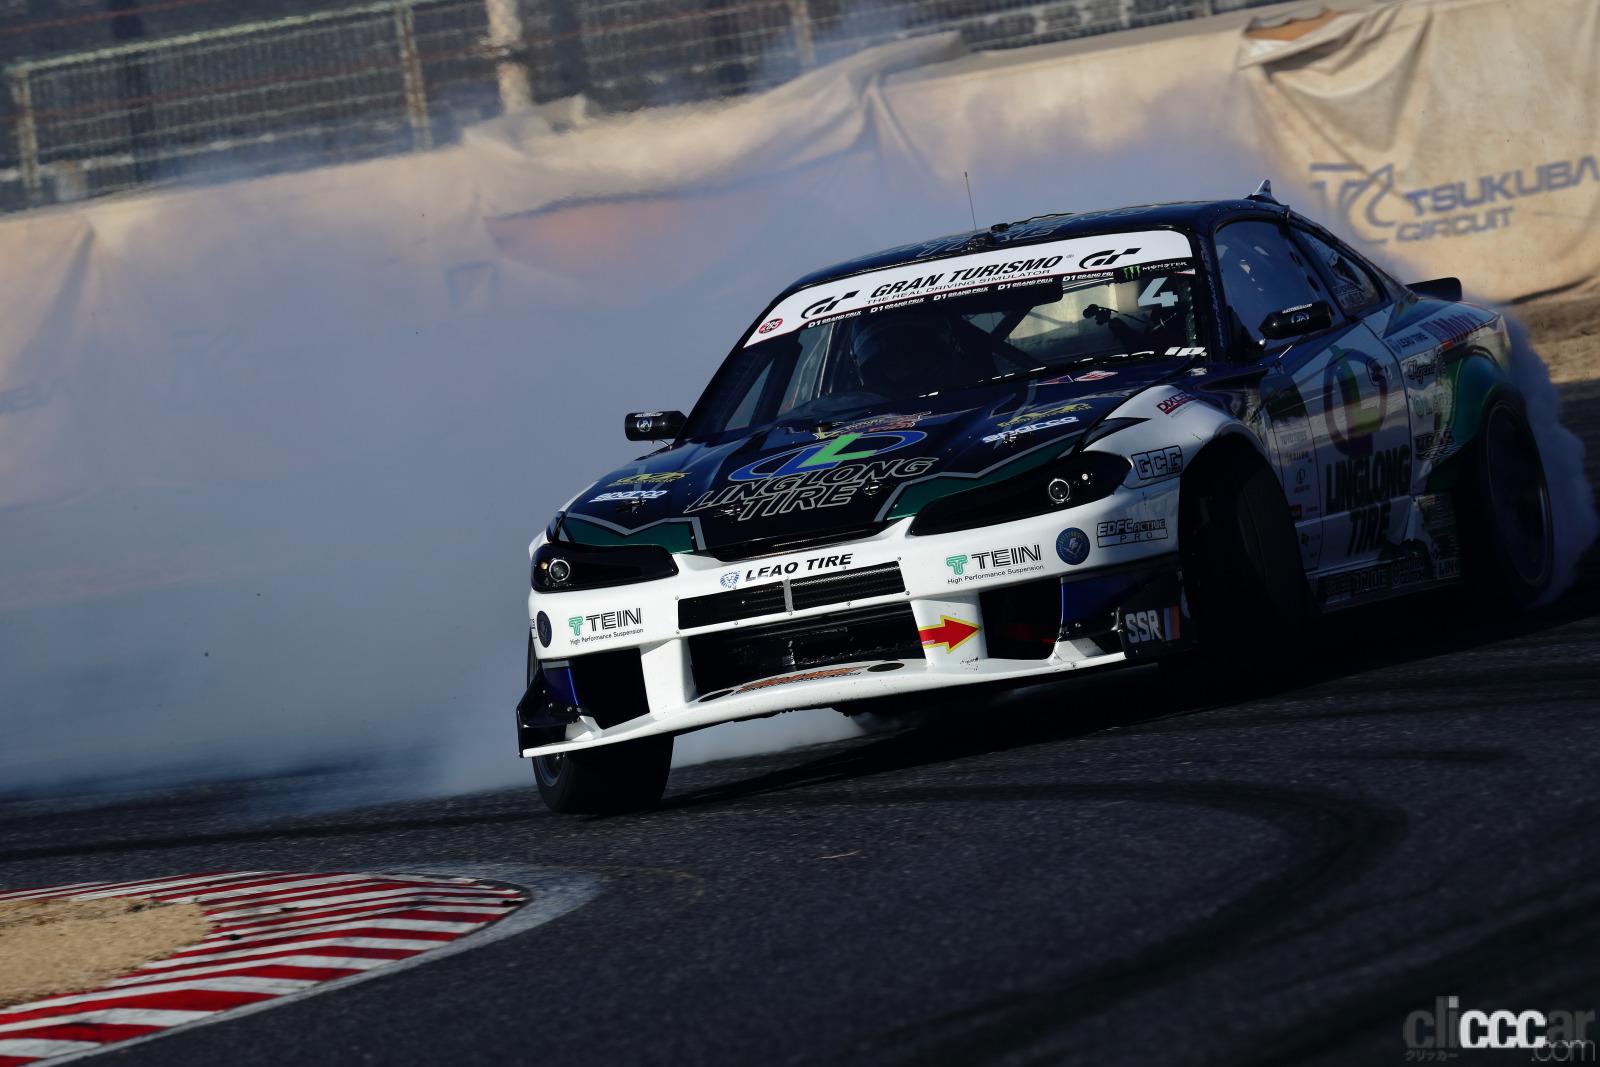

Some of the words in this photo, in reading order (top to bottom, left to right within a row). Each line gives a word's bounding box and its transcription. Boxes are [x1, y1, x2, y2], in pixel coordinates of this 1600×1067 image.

[1404, 154, 1600, 217] TSUKUBA
[1395, 206, 1515, 242] CIRCUIT
[870, 273, 945, 298] GRAN
[953, 255, 1064, 281] TURISMO
[926, 279, 976, 292] DRIVING
[978, 270, 1051, 283] SIMULATOR
[1142, 261, 1188, 271] MONSTER
[1137, 276, 1179, 308] 4
[683, 457, 940, 514] LINGLONG
[1326, 444, 1411, 514] LINGLONG
[738, 485, 858, 522] TIRE
[1097, 518, 1134, 537] EDFC
[1120, 531, 1153, 542] PRO
[1347, 503, 1391, 557] TIRE
[745, 561, 798, 582] LEAO
[806, 553, 853, 571] TIRE
[971, 544, 1042, 570] TEIN
[948, 576, 963, 585] High
[964, 571, 1006, 582] Performance
[1007, 564, 1044, 575] Suspension
[586, 607, 642, 632] TEIN
[1125, 609, 1163, 644] SSR
[581, 633, 612, 644] Performance
[612, 628, 644, 638] Suspension
